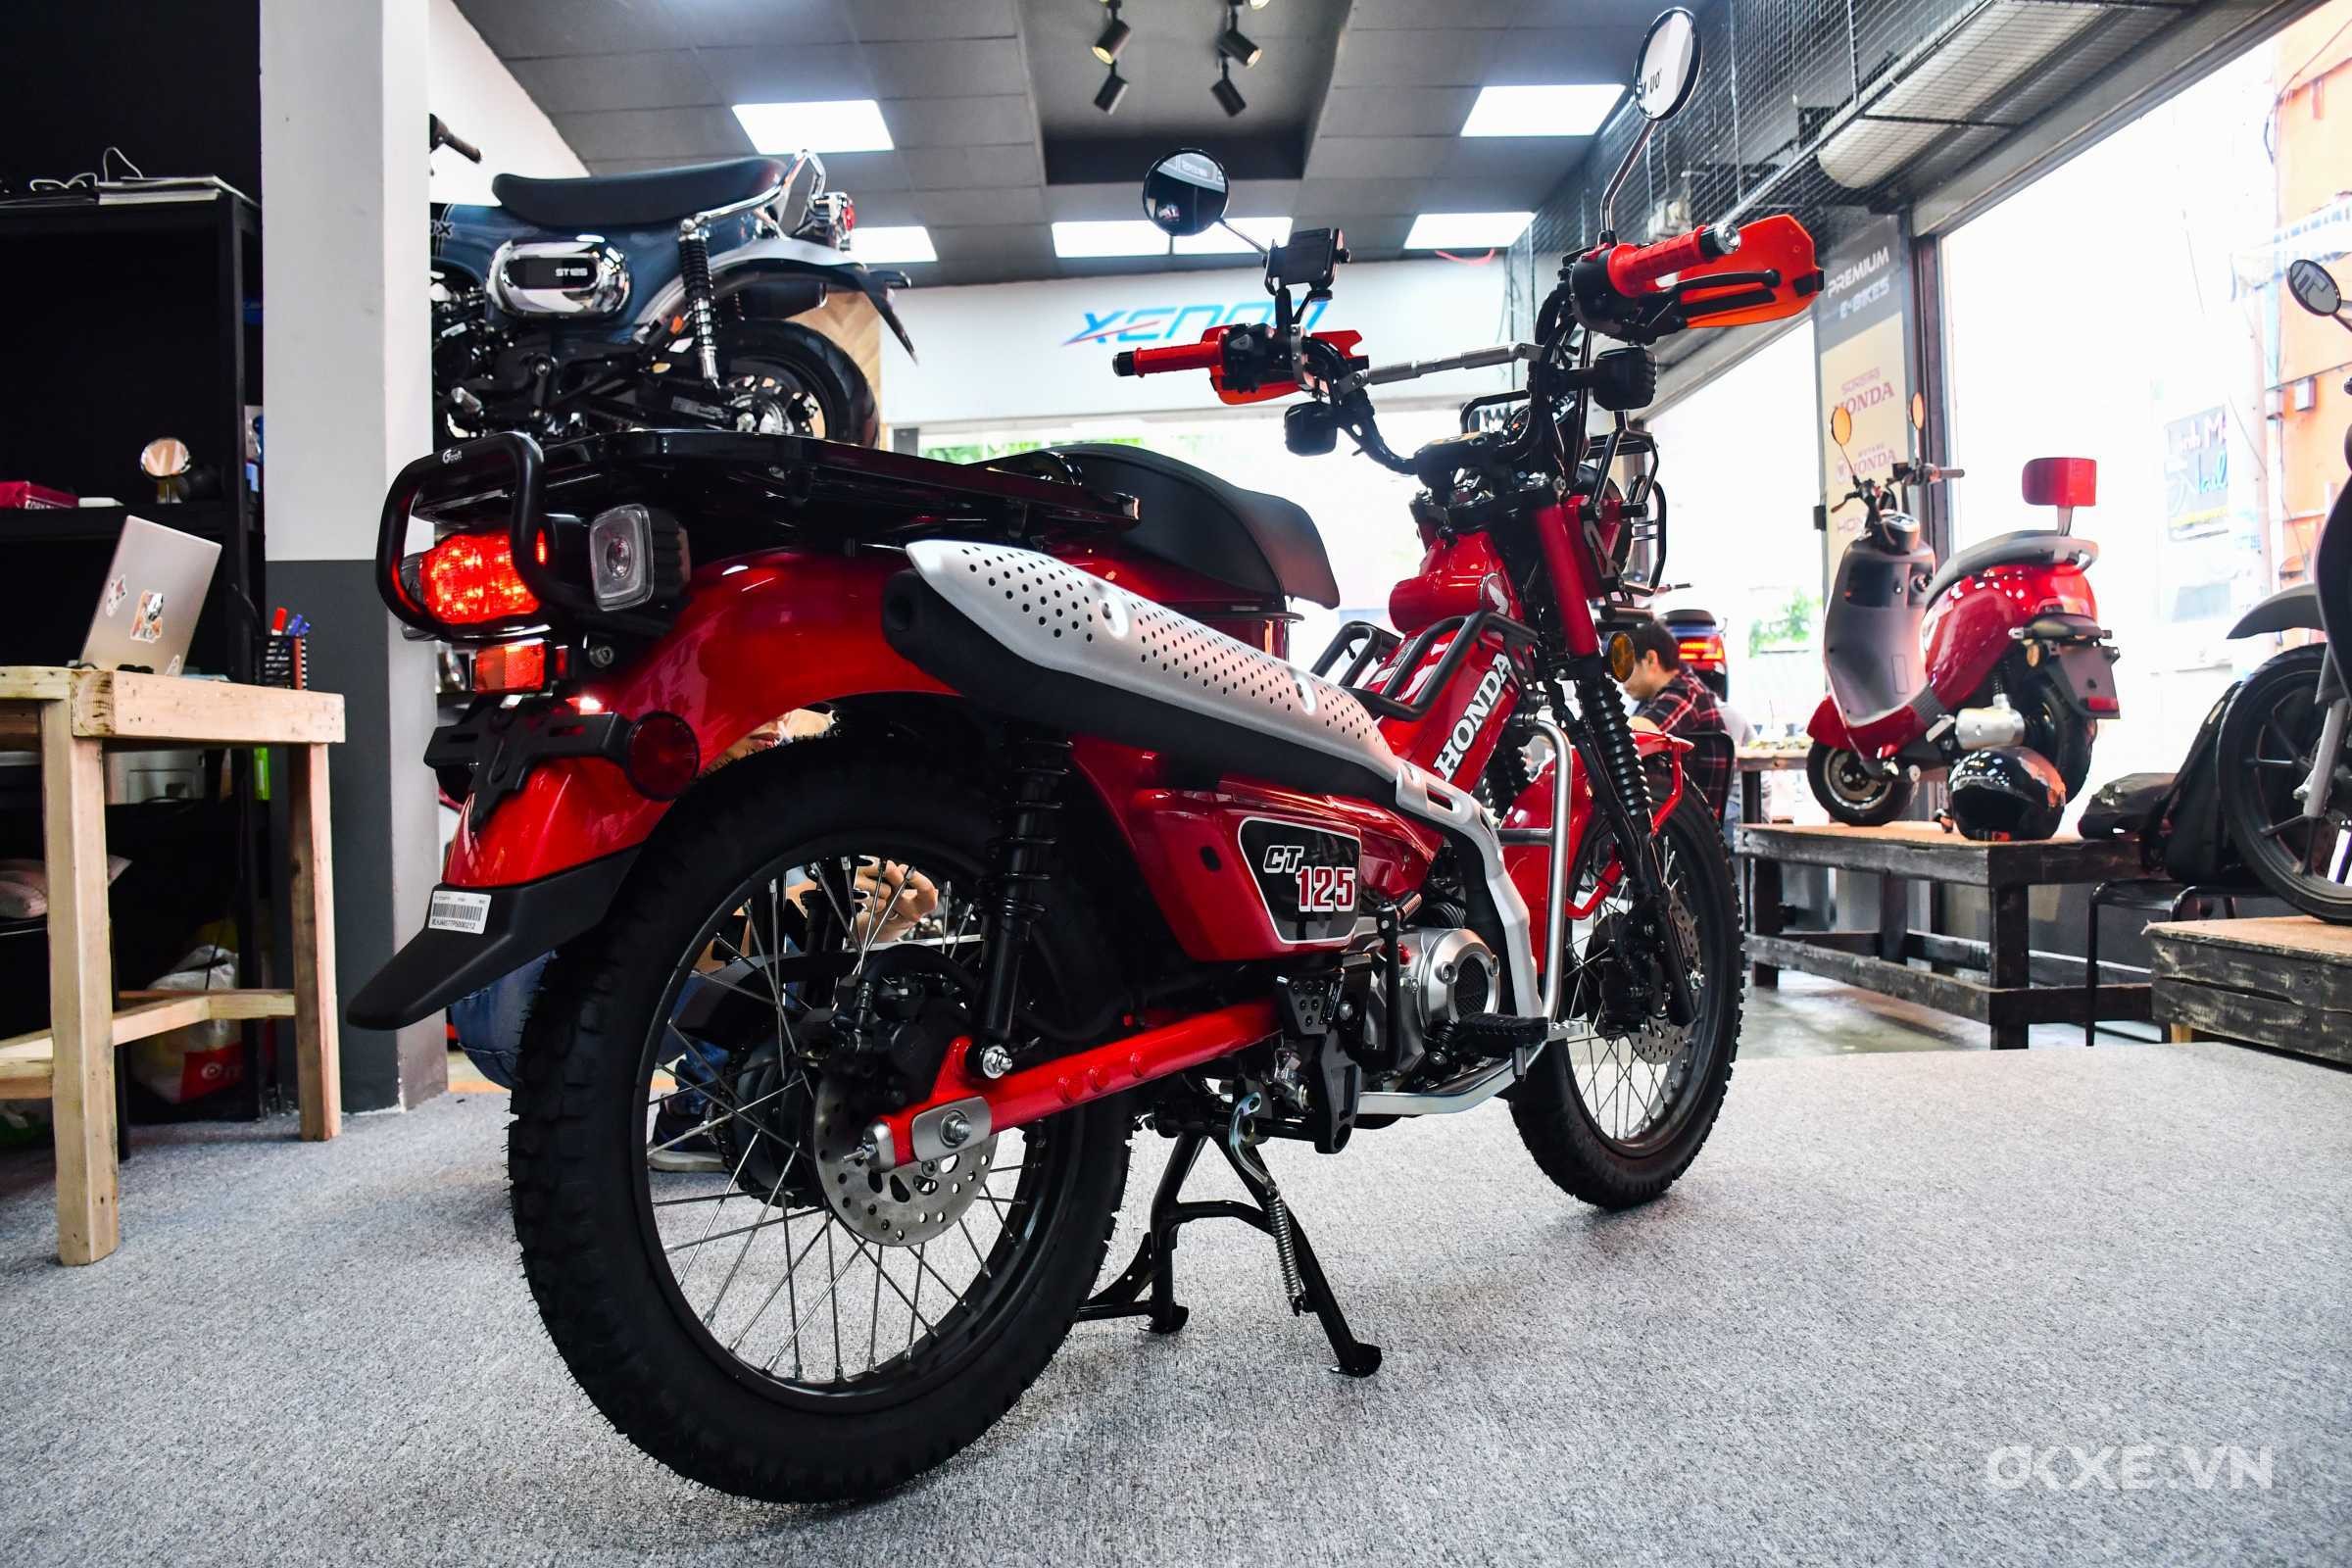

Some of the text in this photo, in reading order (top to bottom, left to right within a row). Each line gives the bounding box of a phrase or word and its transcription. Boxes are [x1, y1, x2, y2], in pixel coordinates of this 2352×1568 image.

[1827, 246, 1889, 298] PREMIUM
[1433, 653, 1513, 783] HONDA
[1263, 845, 1356, 912] CT 125
